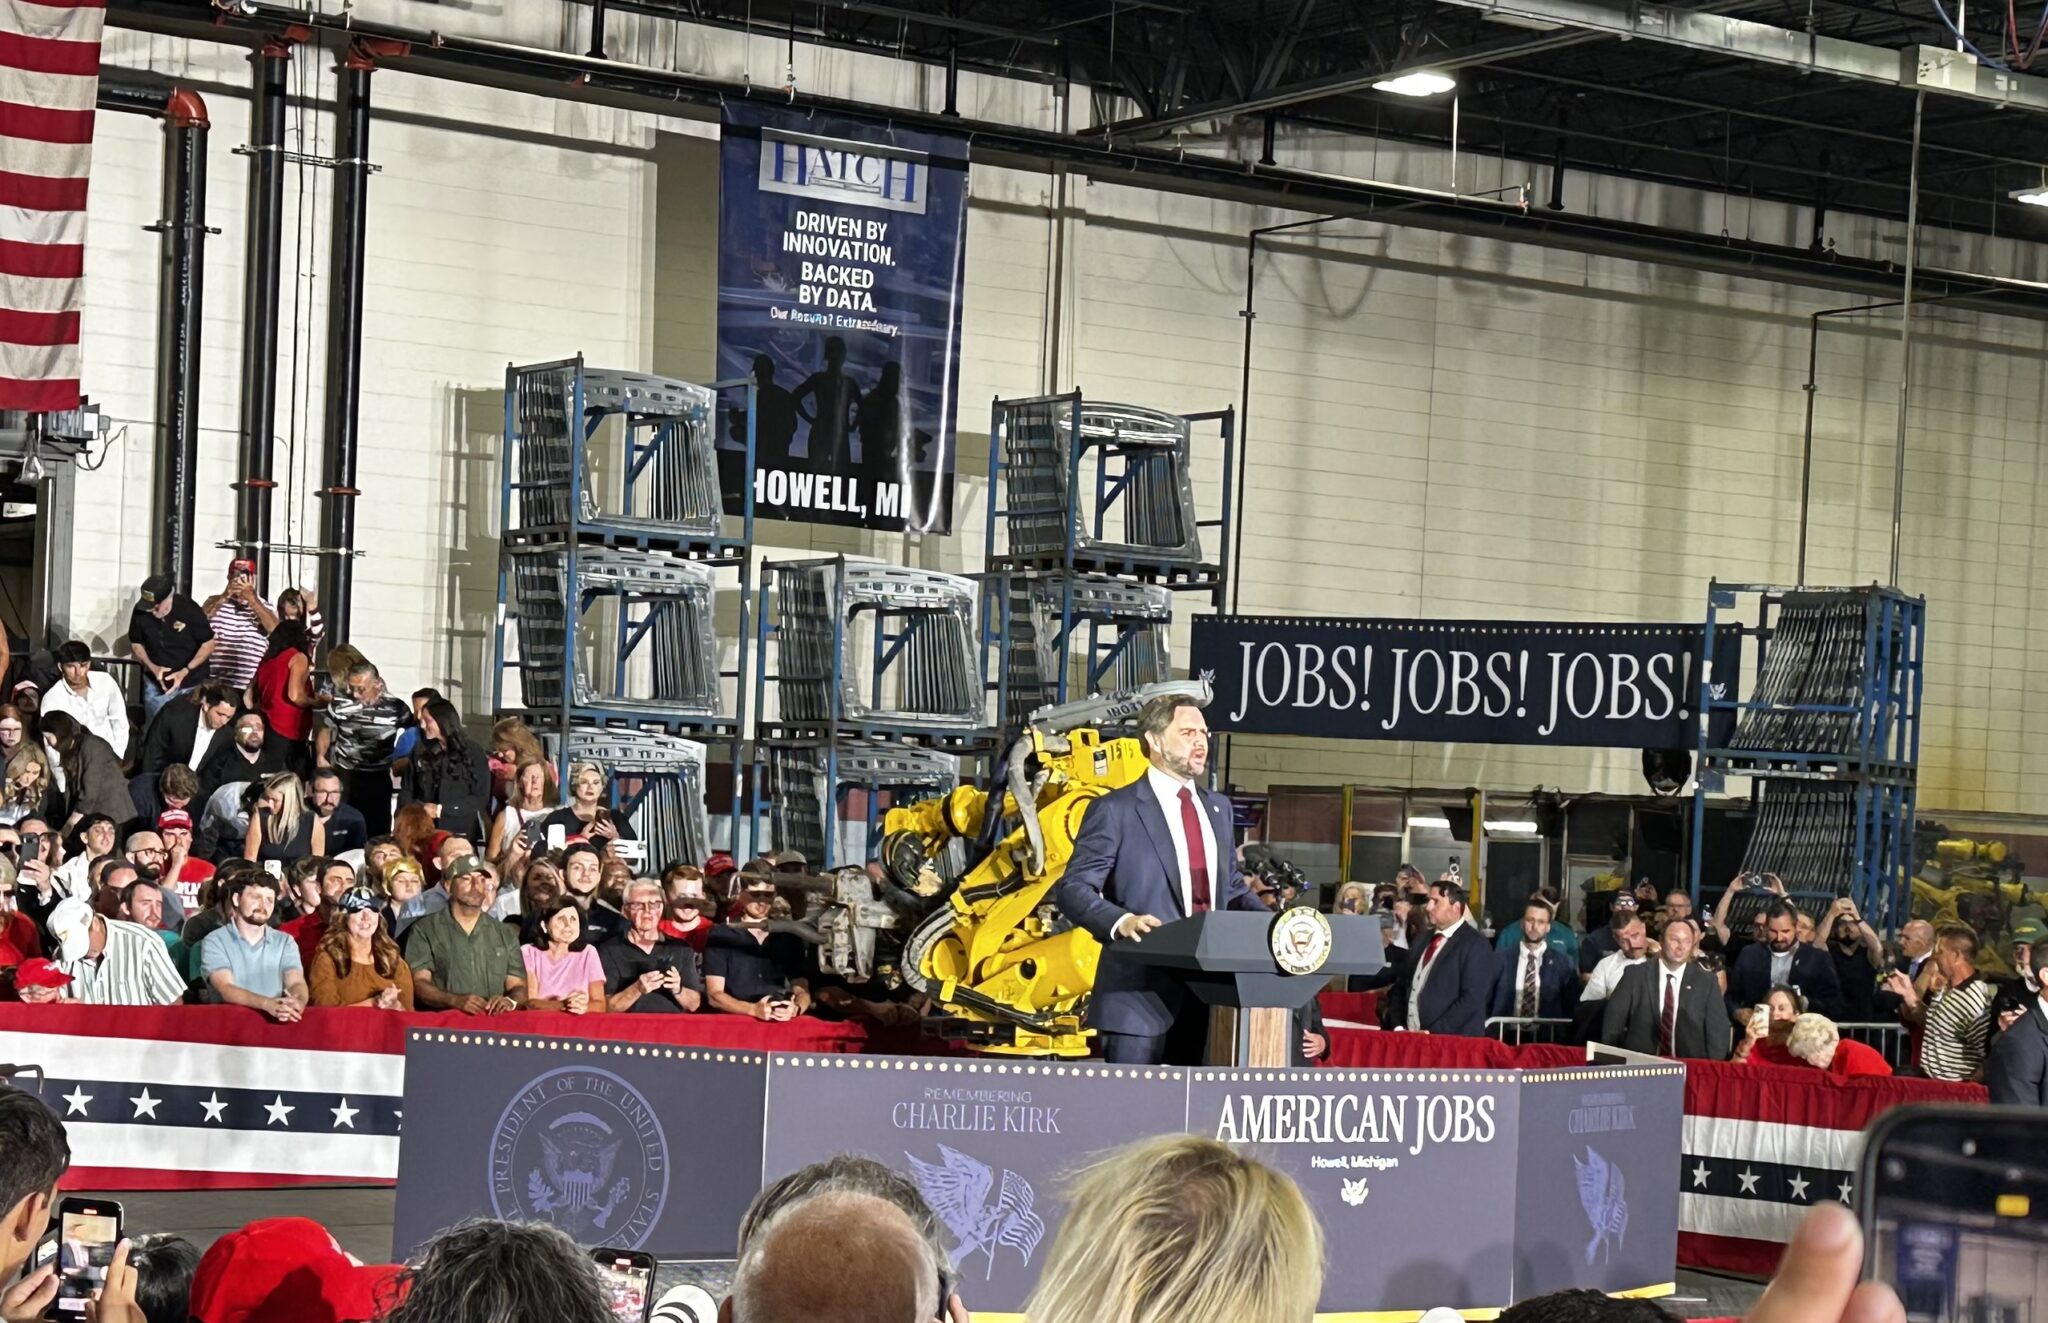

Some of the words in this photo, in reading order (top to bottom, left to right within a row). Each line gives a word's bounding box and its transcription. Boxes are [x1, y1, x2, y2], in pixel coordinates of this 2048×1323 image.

[769, 139, 918, 203] HATCH
[796, 211, 862, 238] DRIVEN
[866, 221, 888, 241] BY
[783, 231, 896, 266] INNOVATION.
[801, 261, 874, 288] BACKED
[770, 306, 788, 320] Our
[799, 284, 823, 305] BY
[826, 288, 877, 313] DATA.
[875, 481, 912, 519] MI
[1229, 641, 1373, 722] JOBS!
[1381, 647, 1529, 730] JOBS!
[1537, 650, 1692, 736] JOBS!
[924, 1088, 1032, 1103] REMEMBERING
[893, 1102, 996, 1131] CHARLIE
[1003, 1105, 1061, 1133] KIRK
[1216, 1094, 1408, 1143] AMERICAN
[1409, 1094, 1496, 1155] JOBS
[495, 1083, 546, 1193] PRESIDENT
[556, 1077, 576, 1092] OF
[584, 1077, 614, 1097] THE
[619, 1092, 663, 1171] UNITED
[1351, 1156, 1398, 1171] Michigan
